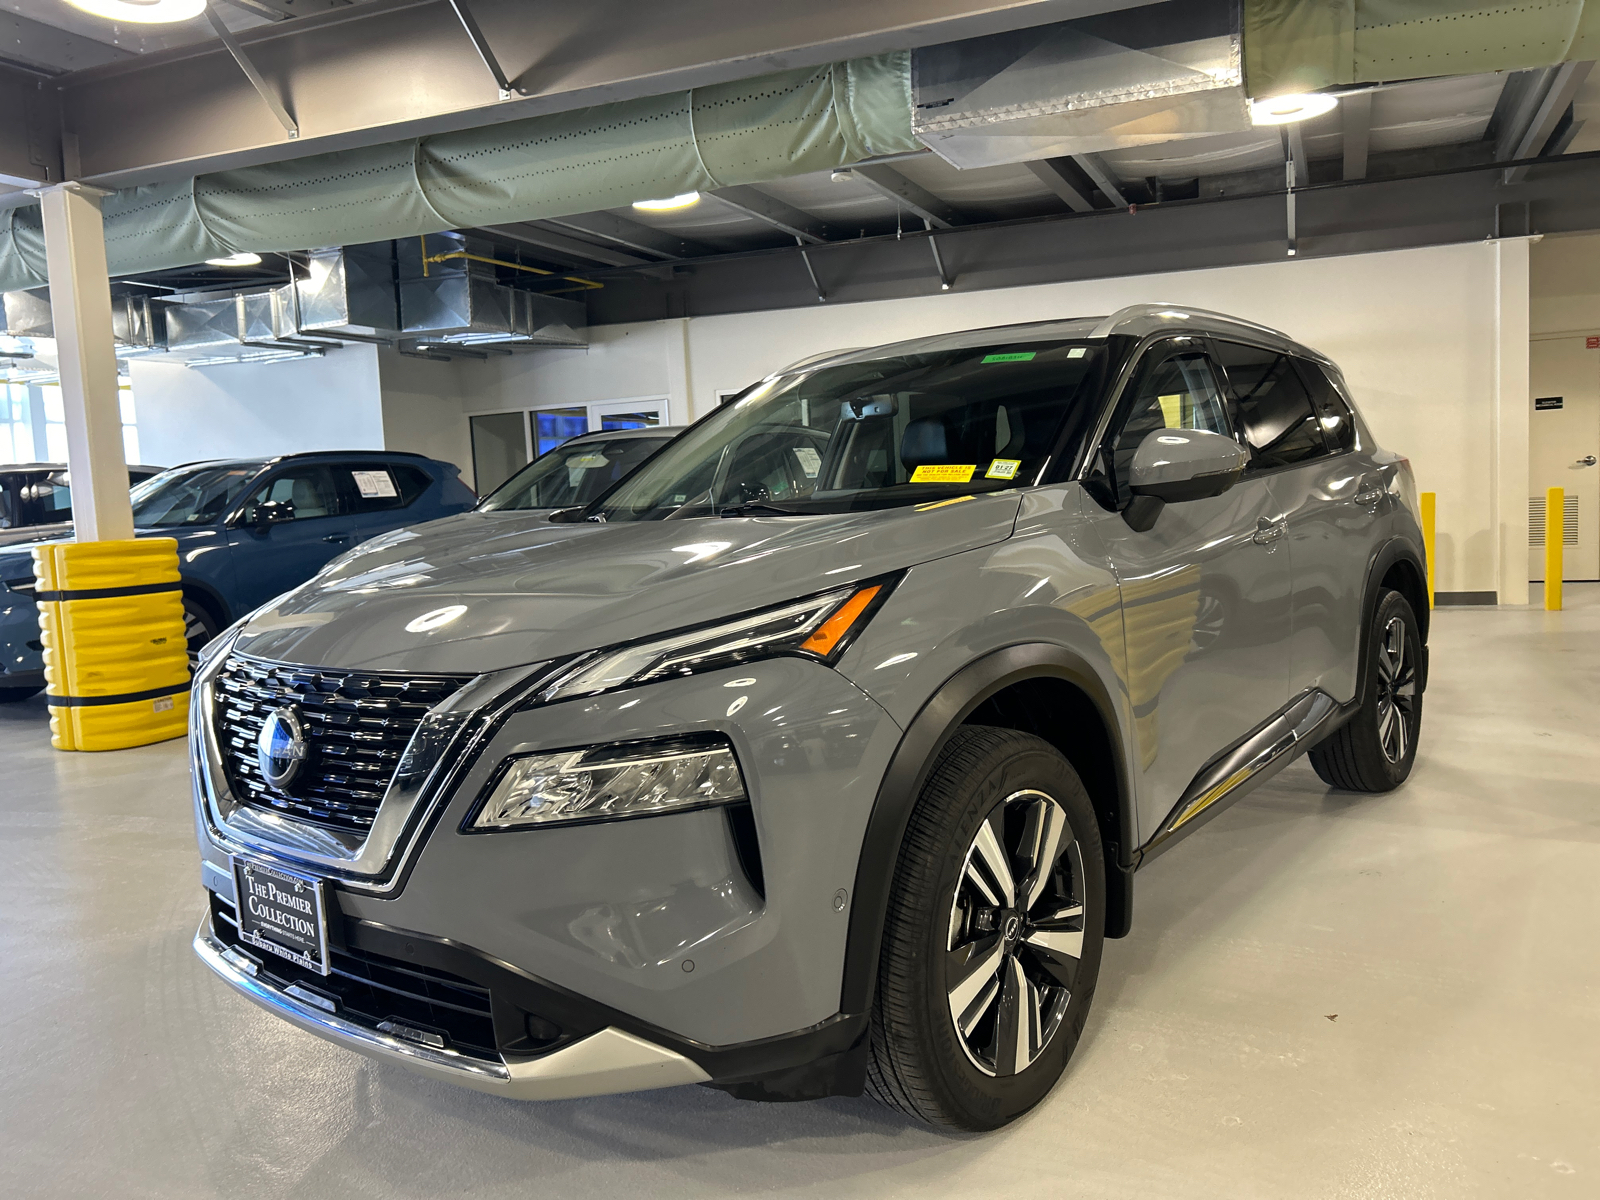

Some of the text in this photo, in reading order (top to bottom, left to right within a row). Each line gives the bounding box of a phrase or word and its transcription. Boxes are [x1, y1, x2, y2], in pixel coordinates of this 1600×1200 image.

[950, 779, 997, 868] ALENZA
[246, 875, 313, 915] THE PREMIER
[248, 895, 315, 938] COLLECTION
[274, 945, 292, 960] White
[293, 954, 313, 969] Plains
